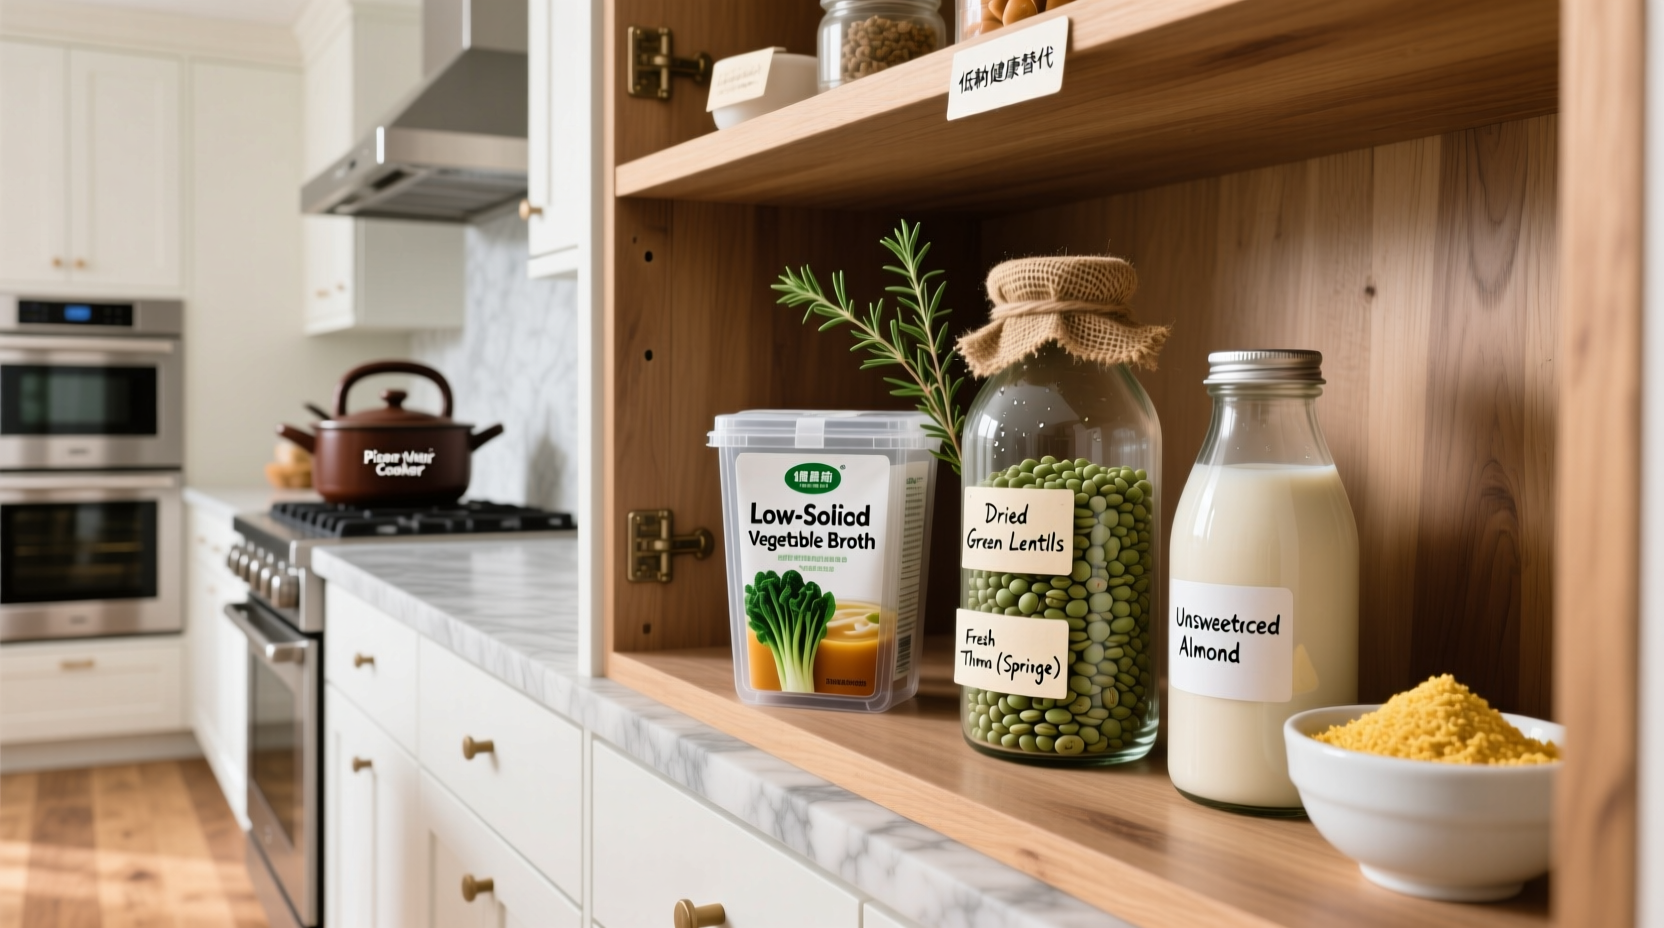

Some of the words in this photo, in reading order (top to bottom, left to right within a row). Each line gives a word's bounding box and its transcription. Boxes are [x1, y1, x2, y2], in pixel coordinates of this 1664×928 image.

[985, 502, 1029, 525] Dried
[748, 530, 824, 552] Vegetable
[827, 531, 876, 550] Broth
[965, 628, 995, 648] Fresh
[1178, 634, 1241, 665] Almond
